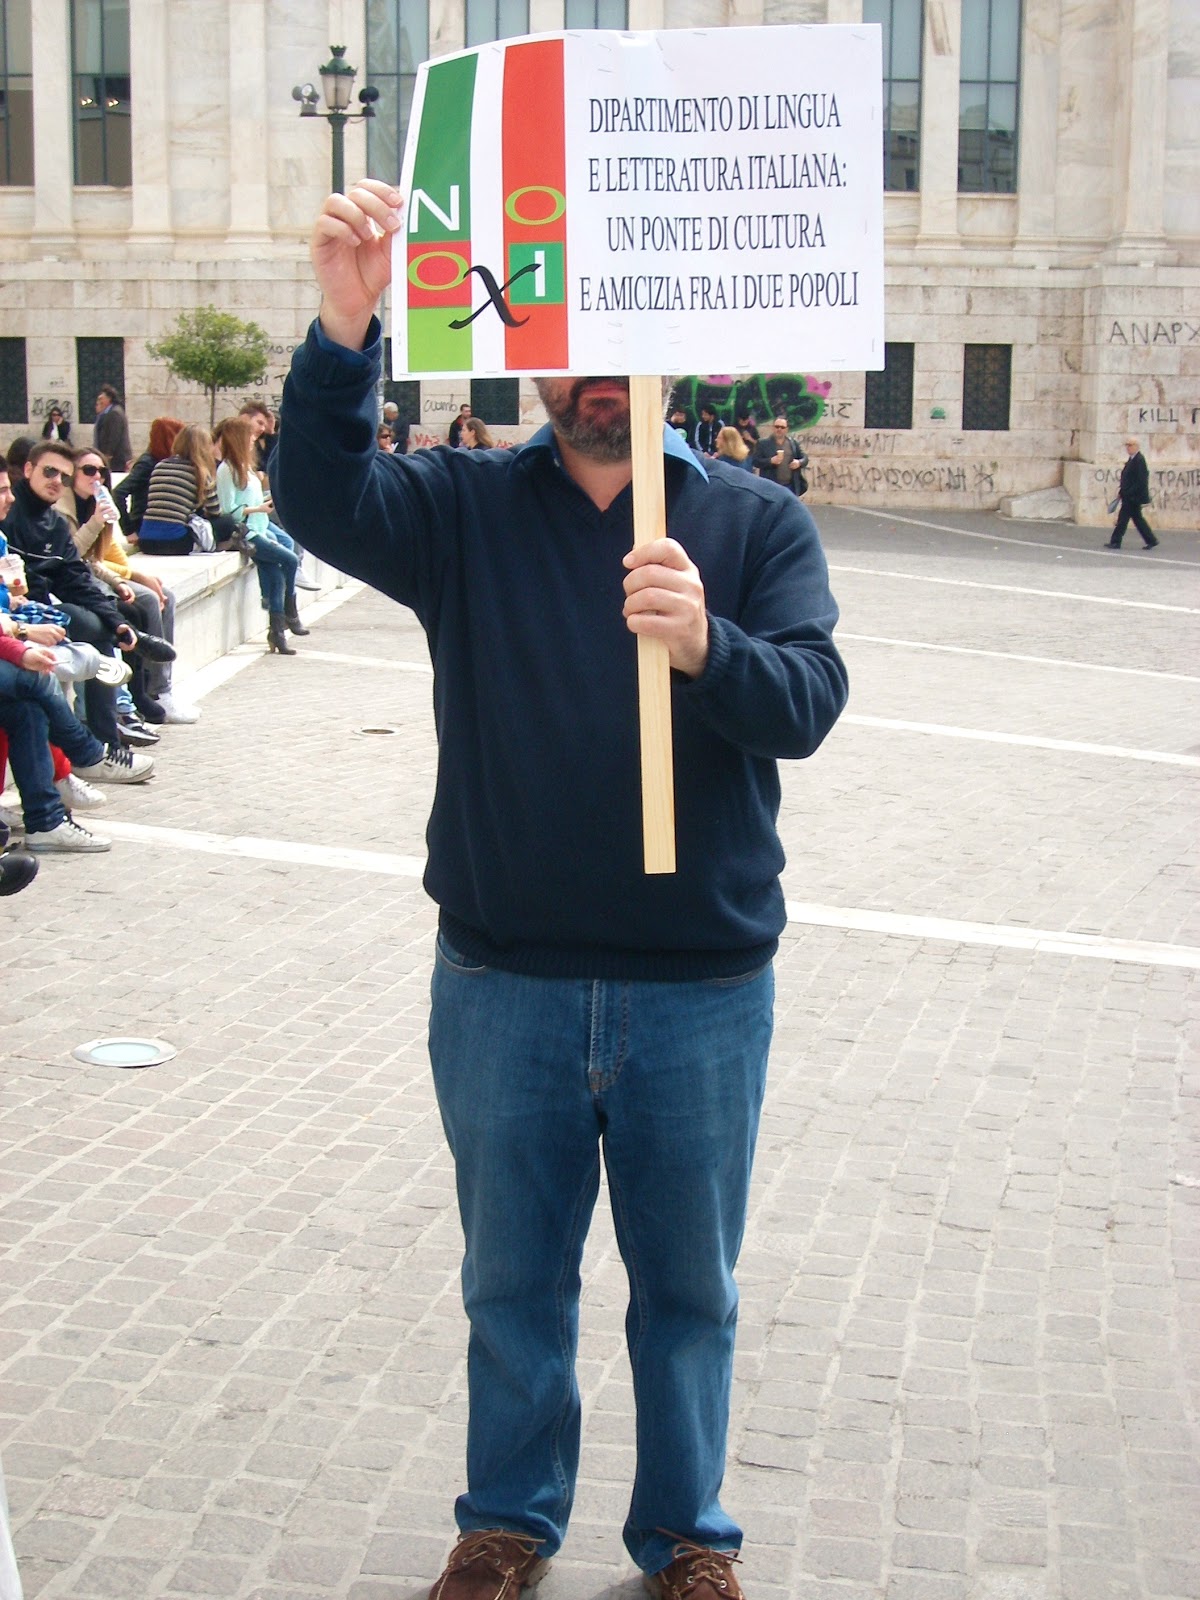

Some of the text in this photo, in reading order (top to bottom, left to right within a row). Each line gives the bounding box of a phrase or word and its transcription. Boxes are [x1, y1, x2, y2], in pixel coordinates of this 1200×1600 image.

[589, 93, 842, 132] DIPARTIMENTO DI LINGUA
[588, 152, 847, 192] E LETTERATURA ITALIANA:
[606, 213, 826, 251] UN PONTE DI CULTURA
[579, 271, 859, 311] E AMICIZIA FRA I DUE POPOLI
[1139, 408, 1179, 423] KILL
